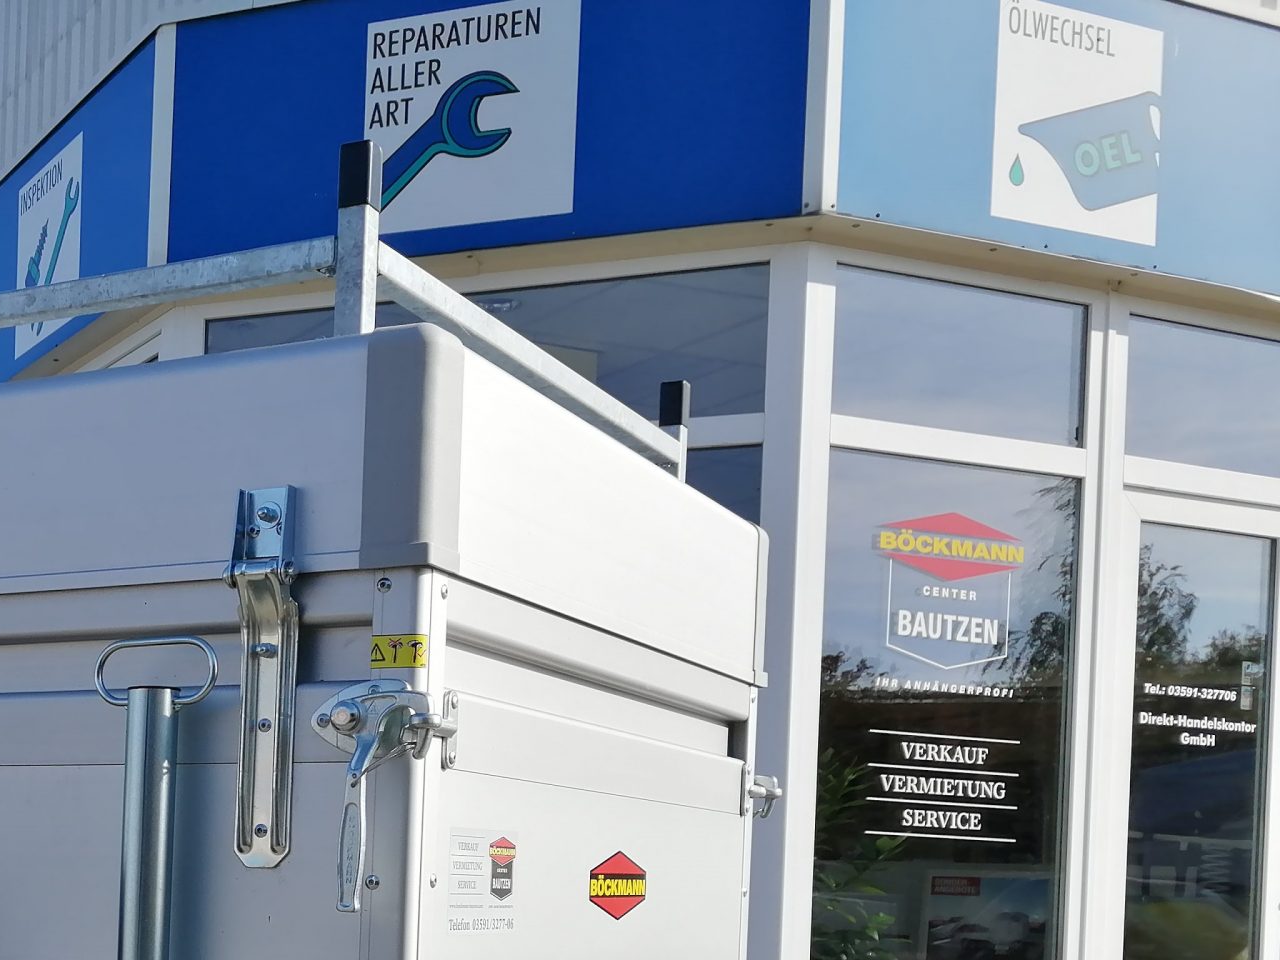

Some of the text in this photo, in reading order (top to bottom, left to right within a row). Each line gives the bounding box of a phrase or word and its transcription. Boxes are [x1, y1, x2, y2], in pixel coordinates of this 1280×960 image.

[373, 7, 542, 59] REPARATUREN
[1009, 0, 1115, 57] ÖLWECHSEL
[370, 58, 441, 95] ALLER
[369, 97, 414, 130] ART
[1073, 129, 1143, 177] OEL
[19, 158, 63, 217] INSPEKTION
[879, 529, 1024, 563] BÖCKMANN
[923, 585, 977, 601] CENTER
[897, 609, 998, 645] BAUTZEN
[875, 677, 1014, 699] IHR ANHÄNGERPROFI
[1143, 682, 1237, 702] Tel.: 03591-327706
[1139, 711, 1257, 733] Direkt-Handelskontor
[1180, 732, 1216, 747] GmbH
[901, 741, 989, 765] VERKAUF
[880, 774, 1006, 800] VERMIETUNG
[901, 809, 982, 831] SERVICE
[590, 875, 646, 896] BÖCKMANN
[449, 918, 470, 931] Telefon
